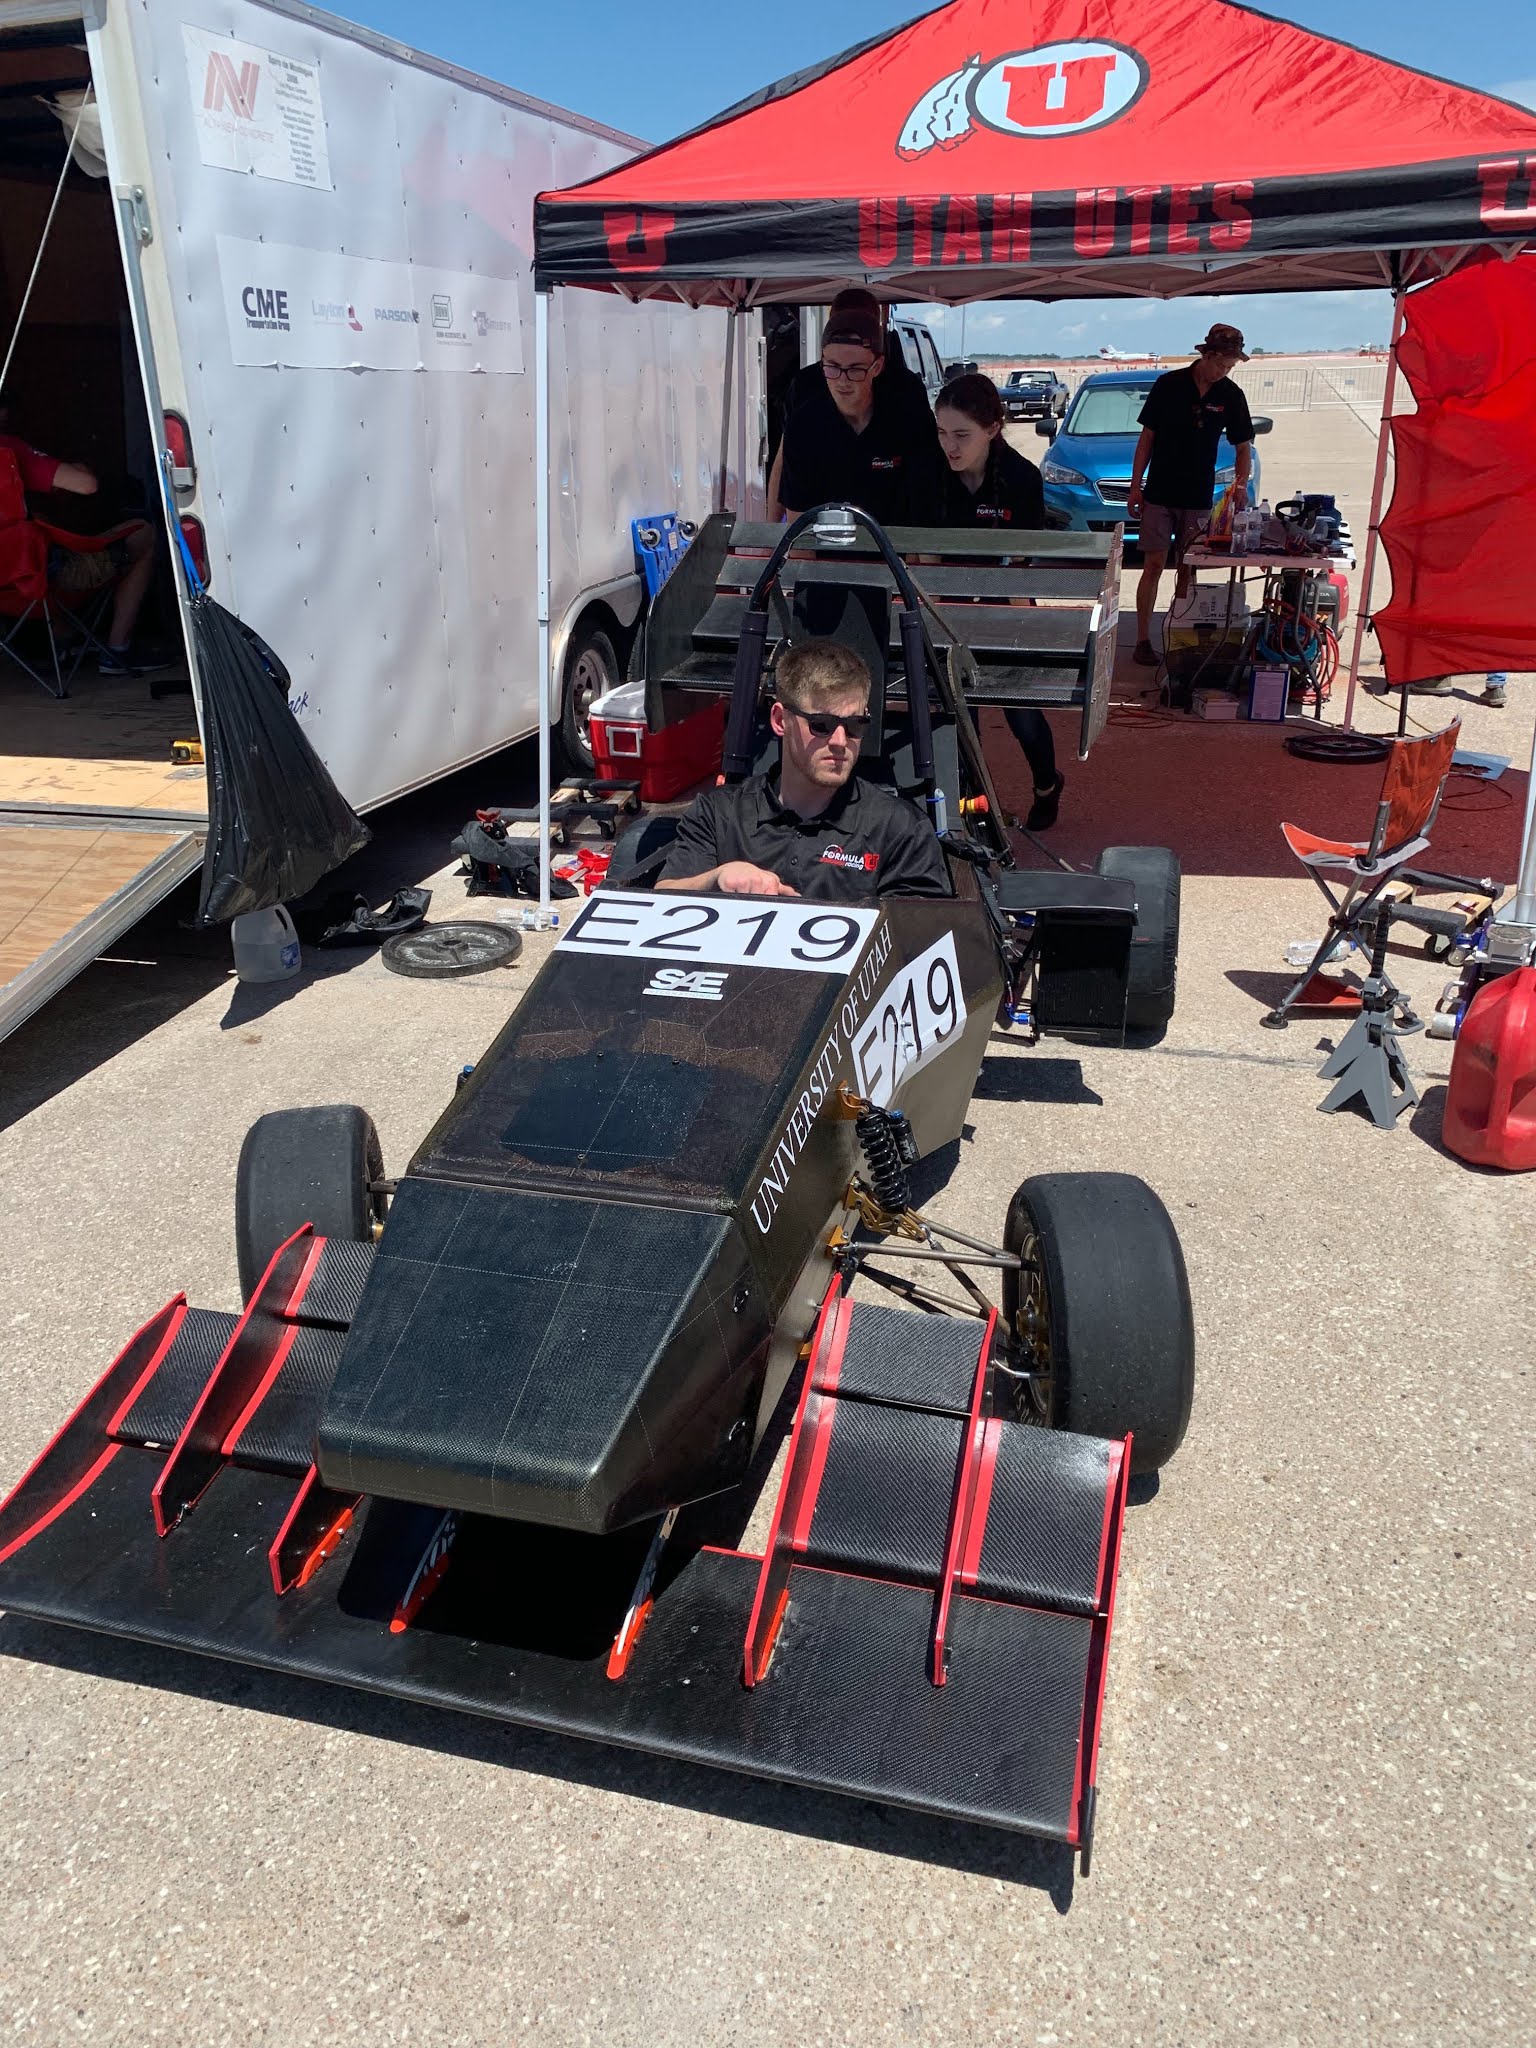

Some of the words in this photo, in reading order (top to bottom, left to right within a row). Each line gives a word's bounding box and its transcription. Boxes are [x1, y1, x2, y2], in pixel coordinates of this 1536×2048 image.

[1001, 54, 1117, 128] U
[603, 210, 676, 273] U
[858, 191, 1033, 268] UTAH
[1073, 180, 1255, 260] UTES
[242, 286, 289, 319] CME
[374, 307, 419, 324] PARSON
[822, 850, 865, 865] FORMULA
[561, 897, 861, 962] E219
[649, 968, 729, 994] SAE
[859, 957, 958, 1098] E219
[749, 1023, 844, 1235] UNIVERSITY
[840, 985, 860, 1039] OF
[861, 918, 893, 1002] UTAH
